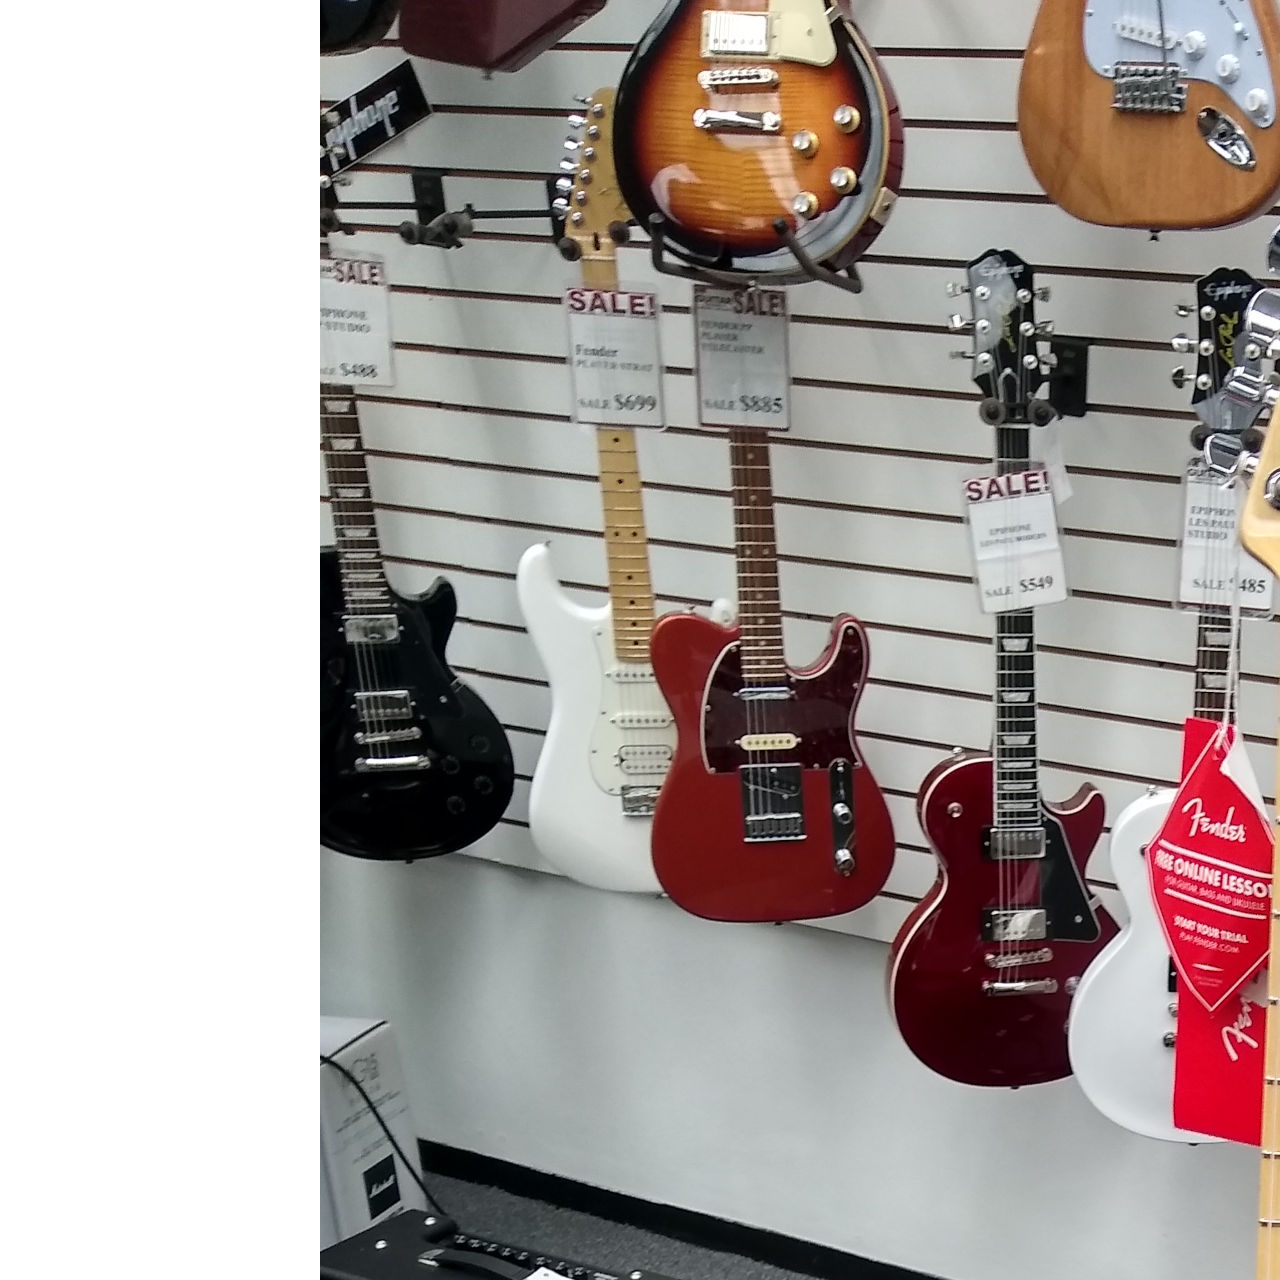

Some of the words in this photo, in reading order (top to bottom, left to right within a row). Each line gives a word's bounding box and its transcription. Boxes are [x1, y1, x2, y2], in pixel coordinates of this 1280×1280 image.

[568, 290, 657, 317] SALE!
[732, 290, 786, 317] SALE!
[613, 393, 658, 412] $699
[739, 394, 783, 415] $885
[967, 471, 1050, 501] SALE!
[1181, 797, 1247, 843] Fender
[1173, 857, 1222, 887] ONLINE
